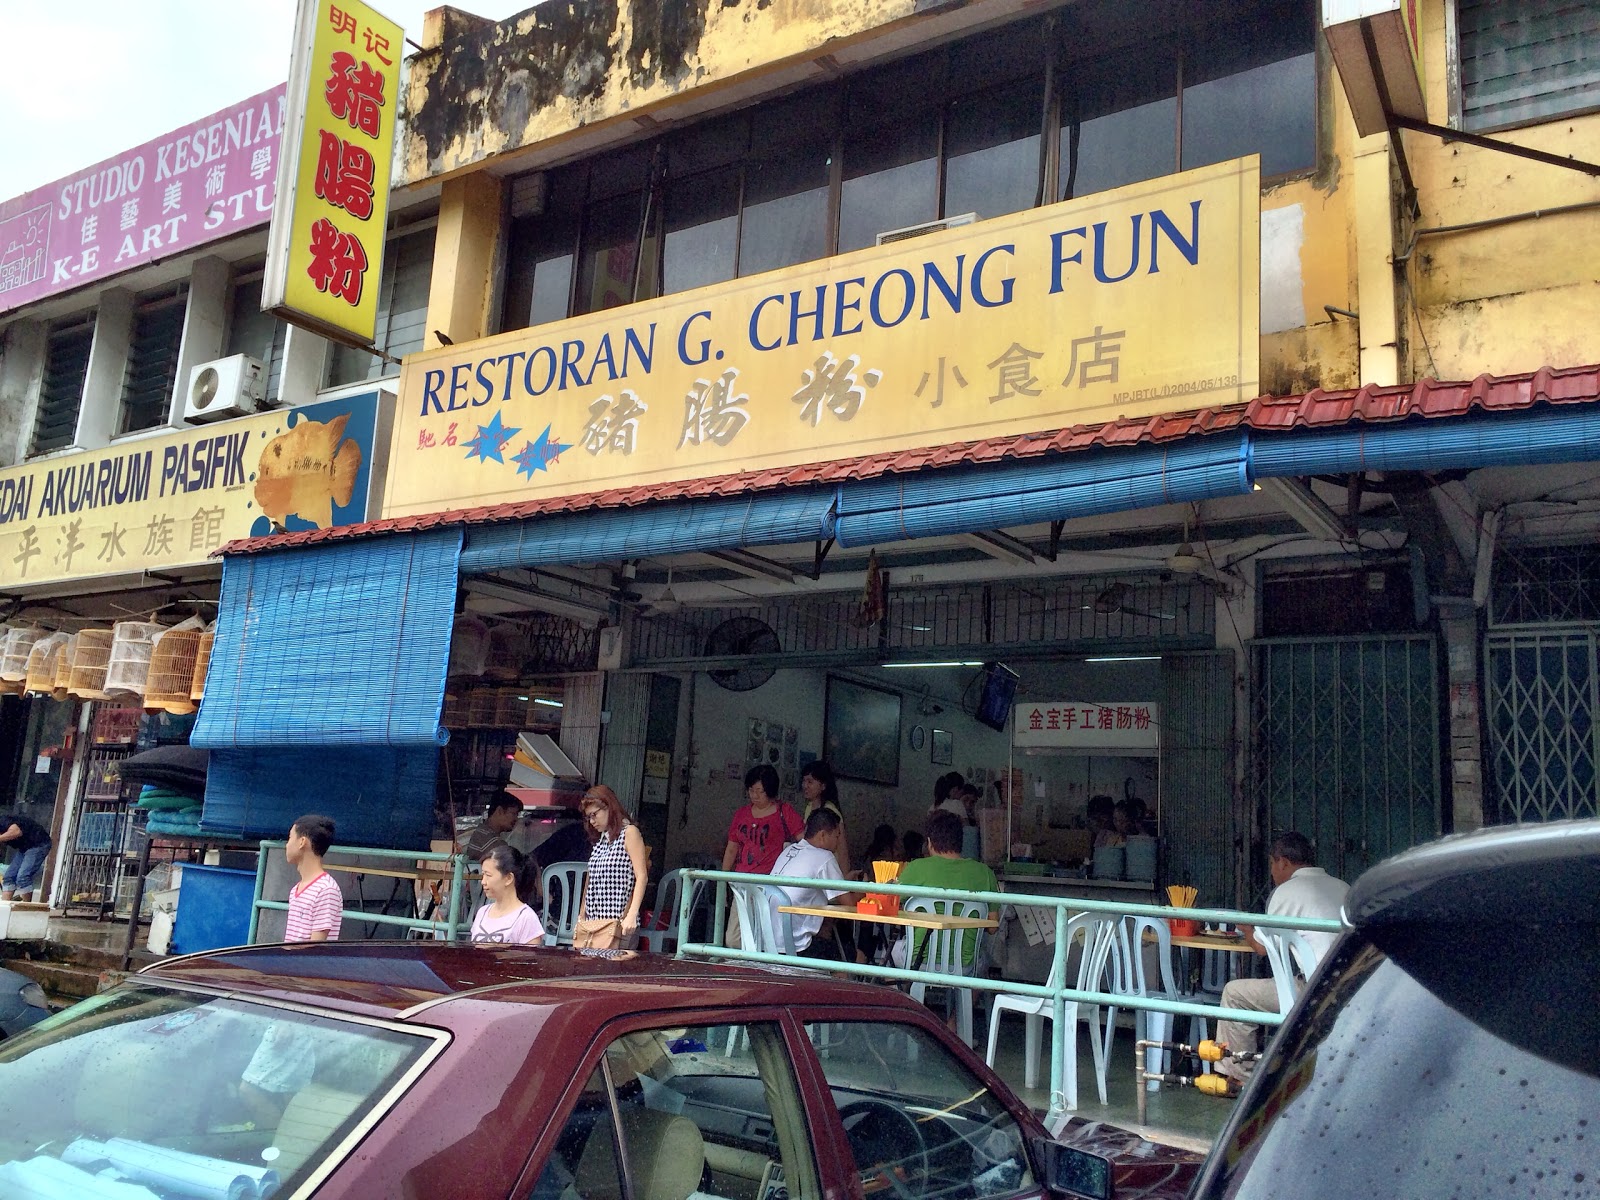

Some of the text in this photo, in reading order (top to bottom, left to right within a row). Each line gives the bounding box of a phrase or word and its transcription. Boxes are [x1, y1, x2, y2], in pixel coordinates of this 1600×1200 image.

[329, 3, 392, 67] 明记
[58, 155, 145, 221] STUDIO
[51, 245, 100, 285] K-E
[113, 213, 188, 263] ART
[419, 322, 657, 418] RESTORAN
[677, 310, 725, 366] G.
[748, 244, 1017, 352] CHEONG
[1047, 199, 1203, 295] FUN
[913, 325, 1127, 408] 小食店
[37, 450, 153, 519] AKUARIUM
[159, 430, 251, 498] PASIFIK
[13, 505, 226, 578] 平洋水族館
[1029, 706, 1151, 730] 金宝手工猪肠粉
